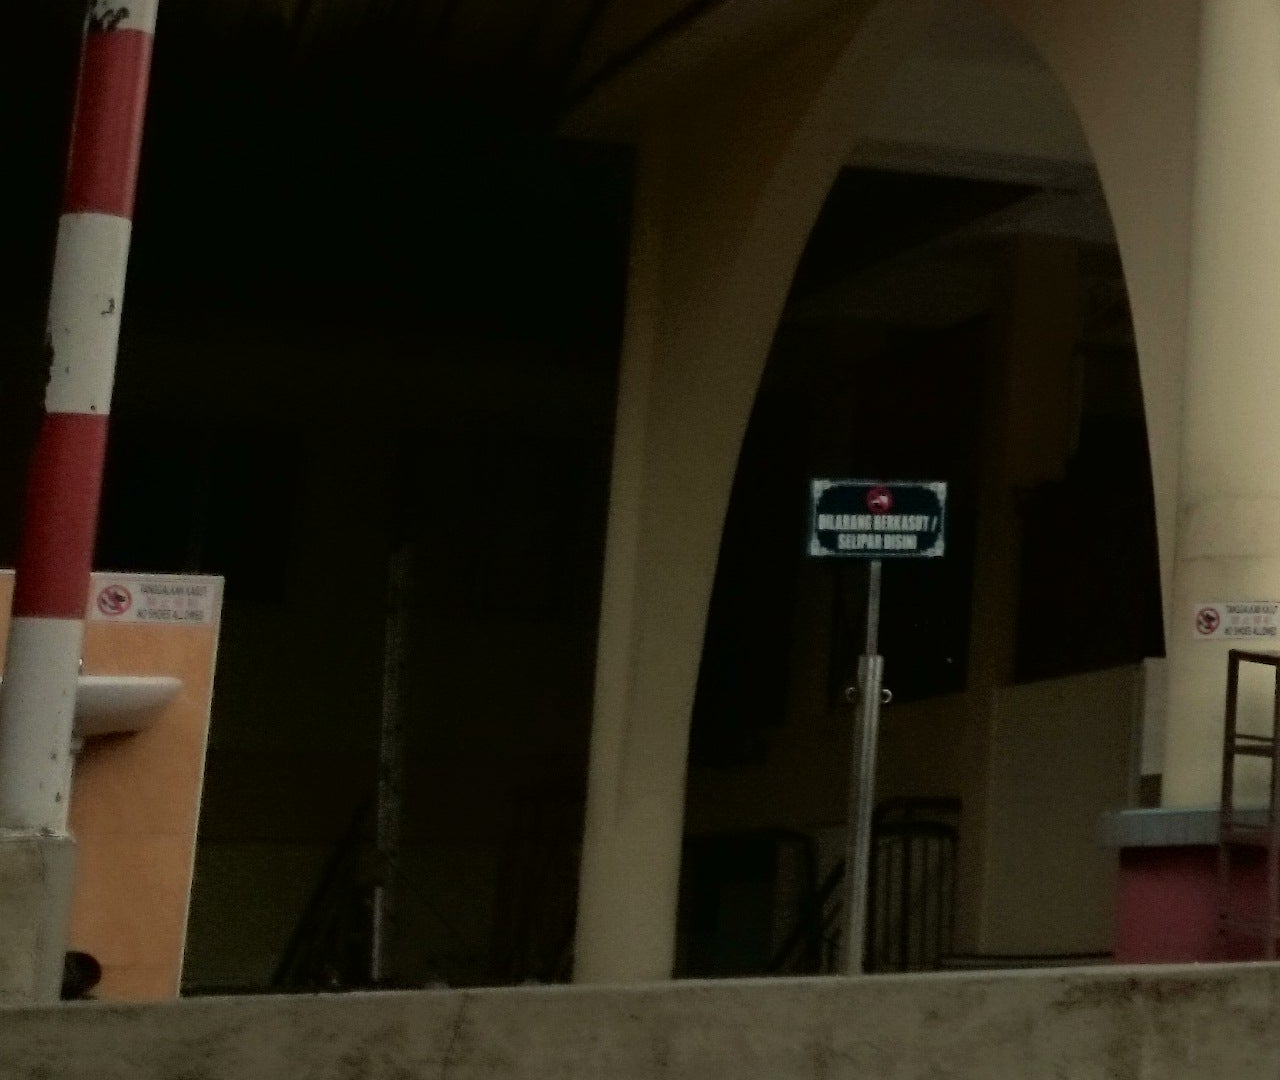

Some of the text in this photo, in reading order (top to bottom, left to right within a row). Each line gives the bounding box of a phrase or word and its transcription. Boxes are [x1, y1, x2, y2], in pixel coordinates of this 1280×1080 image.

[818, 513, 872, 530] DILARANG
[873, 513, 929, 531] BERKASUT
[837, 533, 918, 550] SELIPAR DISINI
